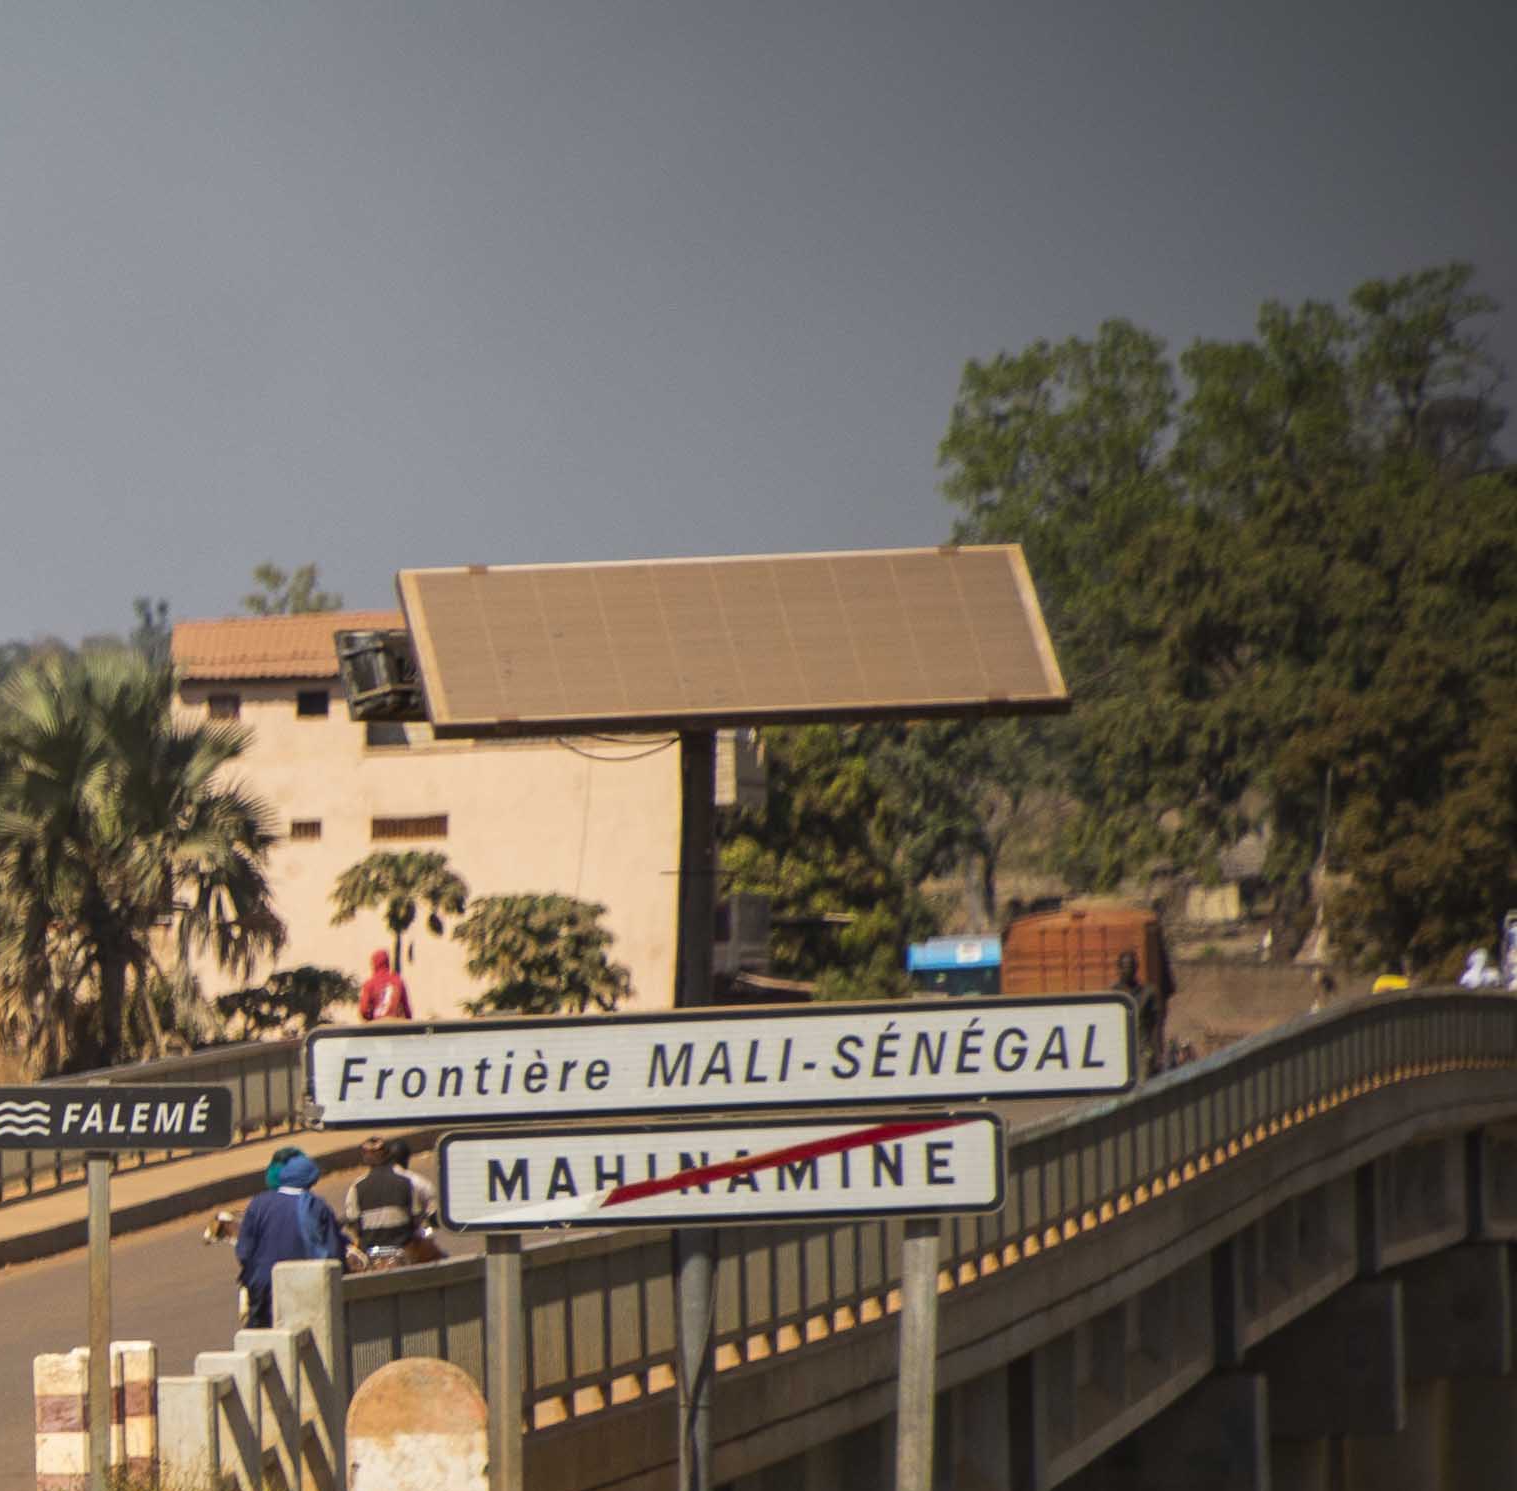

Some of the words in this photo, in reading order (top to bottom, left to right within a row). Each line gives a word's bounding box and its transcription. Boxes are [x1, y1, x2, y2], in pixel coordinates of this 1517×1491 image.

[338, 1050, 611, 1101] Frontière
[647, 1018, 1107, 1087] MALI-SÉNÉGAL
[61, 1095, 210, 1134] FALEMÉ
[487, 1141, 955, 1202] MAHINAMINE
